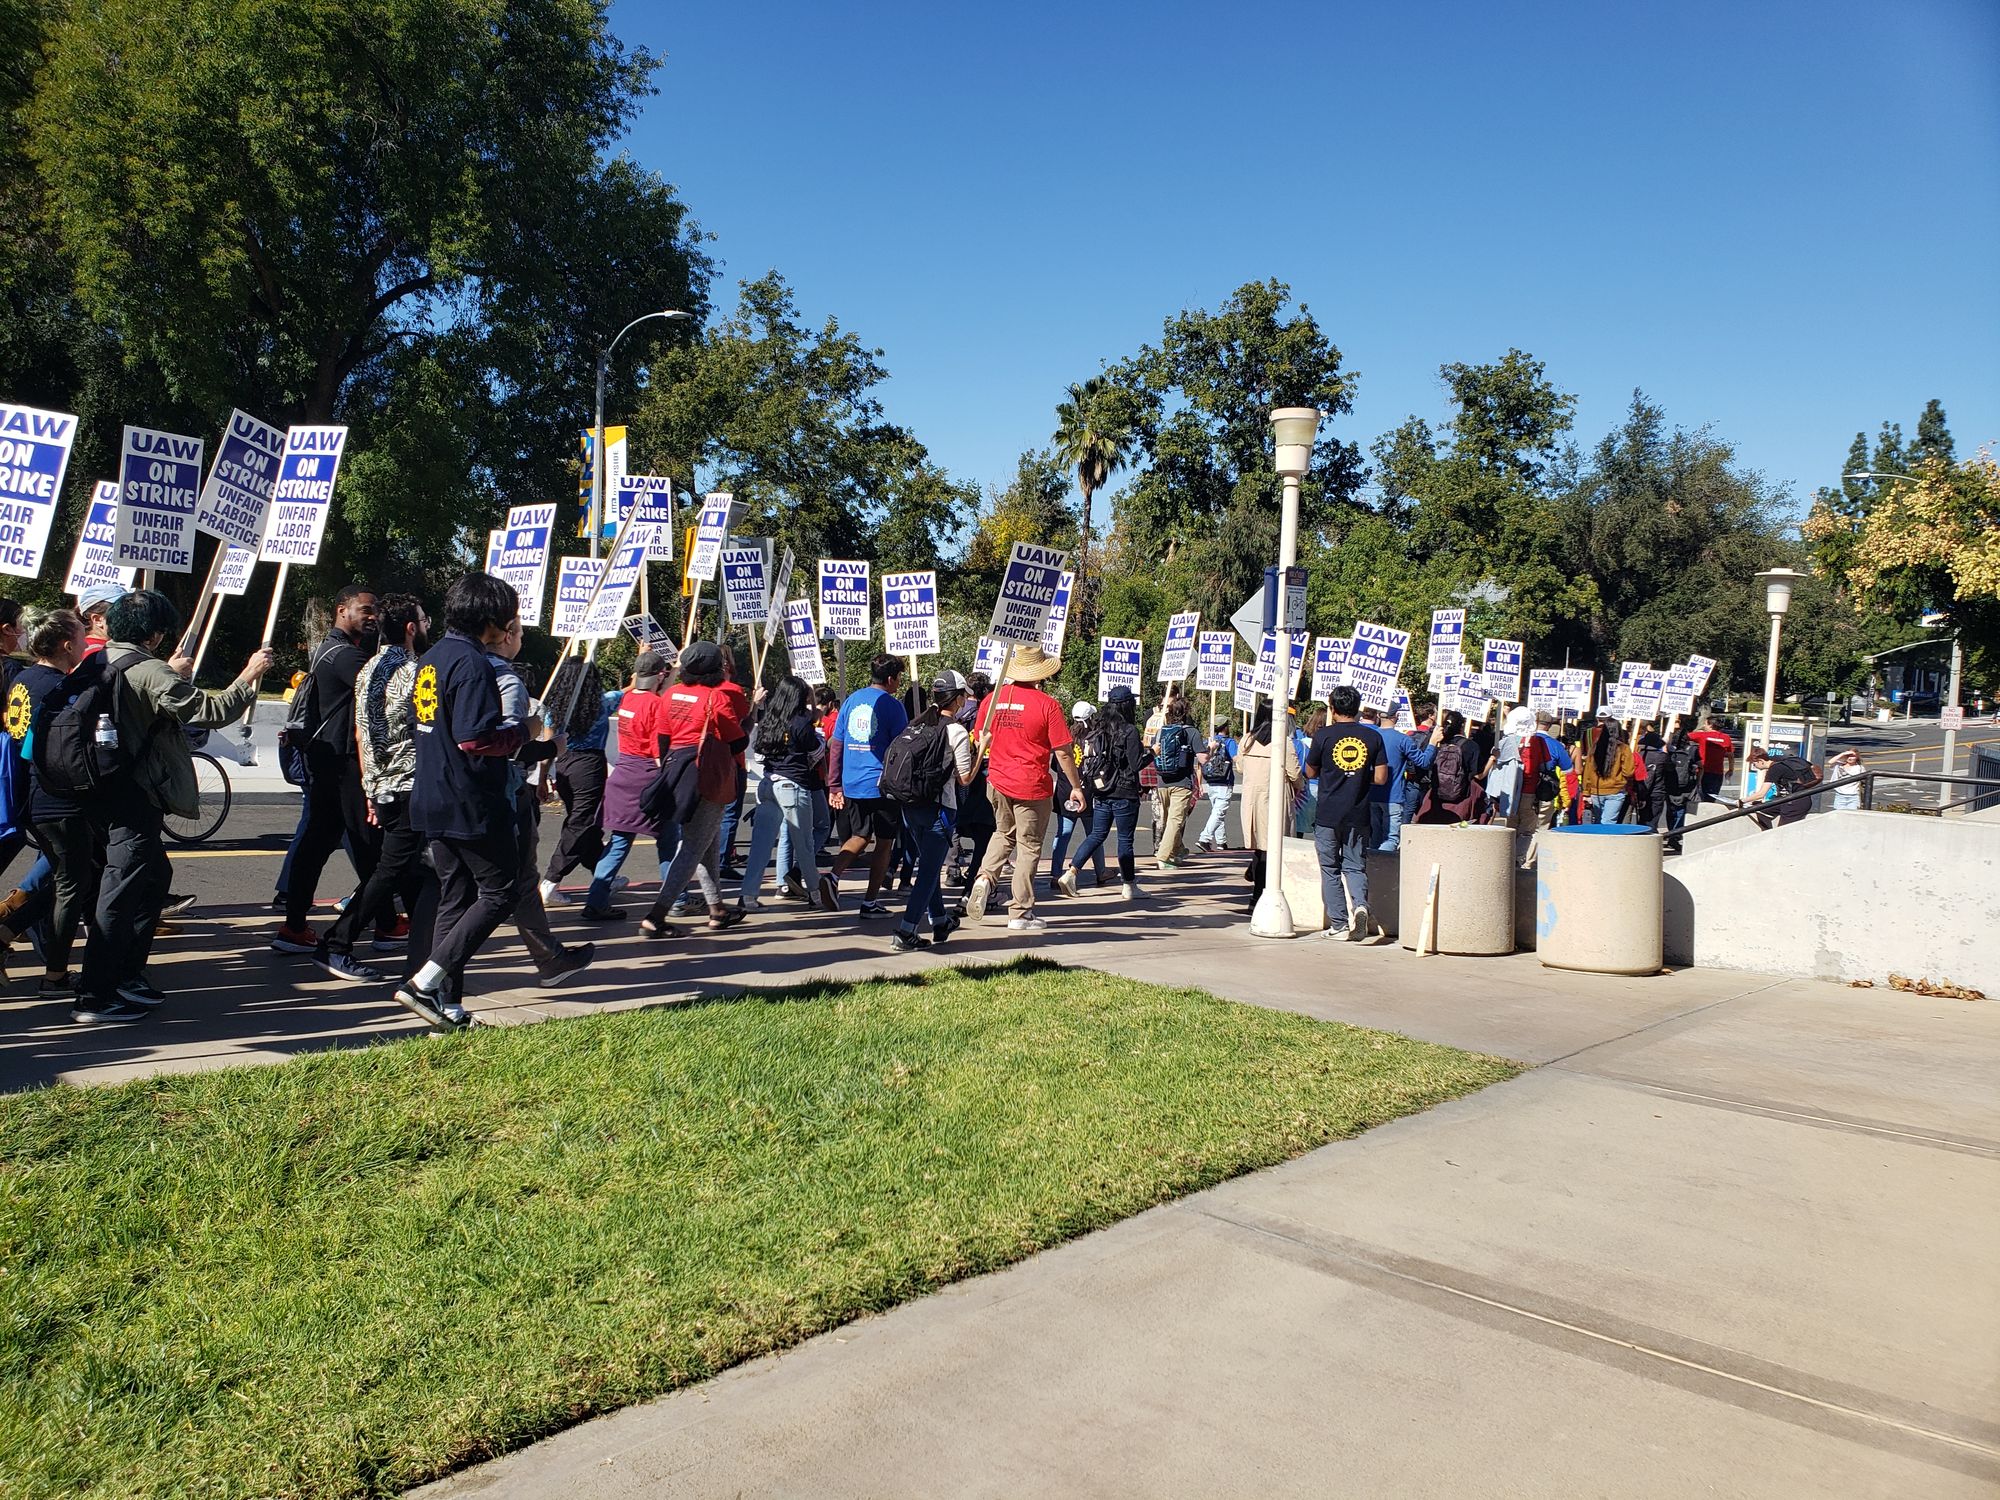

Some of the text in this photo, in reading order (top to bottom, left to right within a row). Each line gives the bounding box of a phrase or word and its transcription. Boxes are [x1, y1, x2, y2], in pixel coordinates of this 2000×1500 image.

[132, 432, 200, 461] UAW
[289, 431, 343, 451] UAW
[243, 449, 269, 474] ON
[296, 458, 319, 477] ON
[149, 462, 177, 484] ON
[218, 459, 276, 499] STRIKE
[277, 479, 331, 500] STRIKE
[620, 477, 667, 490] UAW
[126, 480, 195, 509] STRIKE
[217, 484, 264, 516] UNFAIR
[707, 497, 729, 509] UAW
[213, 500, 257, 529] LABOR
[278, 505, 318, 522] UNFAIR
[510, 508, 552, 527] UAW
[708, 511, 719, 526] ON
[132, 511, 184, 531] UNFAIR
[84, 522, 114, 543] STR
[198, 510, 260, 548] PRACTICE
[276, 523, 312, 538] LABOR
[700, 526, 723, 540] STRIKE
[133, 529, 180, 548] LABOR
[515, 530, 535, 548] ON
[624, 529, 652, 546] AW
[266, 539, 317, 556] PRACTICE
[697, 544, 715, 554] UNFAIR
[86, 548, 113, 563] UNFA
[119, 544, 189, 566] PRACTICE
[502, 548, 544, 566] STRIKE
[696, 555, 711, 565] LABOR
[722, 551, 760, 564] UAW
[1016, 545, 1065, 568] UAW
[83, 562, 120, 579] LABOR
[219, 564, 244, 576] ABOR
[502, 569, 534, 582] UNFAIR
[690, 564, 713, 576] PRACTICE
[736, 565, 752, 577] ON
[824, 563, 866, 575] UAW
[1024, 567, 1046, 583] ON
[575, 575, 595, 588] ON
[727, 578, 764, 590] STRIKE
[835, 578, 854, 590] ON
[886, 574, 931, 588] UAW
[560, 587, 590, 600] STRI
[733, 591, 762, 602] UNFAIR
[823, 590, 867, 603] STRIKE
[900, 589, 919, 603] ON
[1005, 580, 1053, 602] STRIKE
[597, 591, 624, 606] UNFAIR
[594, 605, 617, 619] LABOR
[736, 601, 762, 611] LABOR
[782, 603, 808, 619] UAW
[829, 606, 862, 616] UNFAIR
[887, 601, 934, 617] STRIKE
[1006, 602, 1042, 618] UNFAIR
[732, 609, 769, 620] PRACTICE
[1172, 615, 1197, 626] UAW
[1436, 612, 1463, 622] UAW
[585, 619, 619, 634] PRACTICE
[791, 620, 805, 634] ON
[831, 617, 860, 626] LABOR
[894, 619, 929, 631] UNFAIR
[1003, 614, 1037, 630] LABOR
[824, 626, 867, 636] PRACTICE
[896, 630, 927, 640] LABOR
[992, 624, 1041, 643] PRACTICE
[1175, 627, 1188, 638] ON
[1358, 625, 1407, 646] UAW
[1441, 624, 1454, 634] ON
[787, 633, 816, 648] STRIKE
[1166, 637, 1192, 650] STRIKE
[1203, 633, 1232, 642] UAW
[1432, 633, 1461, 644] STRIKE
[889, 639, 936, 651] PRACTICE
[1105, 639, 1140, 650] UAW
[1209, 644, 1223, 654] ON
[1367, 643, 1389, 659] ON
[1434, 647, 1455, 655] UNFAIR
[1488, 641, 1521, 652] UAW
[794, 650, 816, 660] UNFAIR
[1114, 651, 1130, 663] ON
[1166, 652, 1186, 661] UNFAIR
[1200, 653, 1231, 663] STRIKE
[1328, 651, 1345, 662] ON
[1496, 653, 1511, 663] ON
[1693, 656, 1714, 666] UAW
[797, 660, 817, 671] LABOR
[1103, 660, 1139, 674] STRIKE
[1165, 660, 1183, 669] LABOR
[1203, 665, 1226, 673] UNFAIR
[1350, 653, 1398, 675] STRIKE
[1429, 663, 1457, 671] PRACTICE
[1485, 661, 1519, 674] STRIKE
[1675, 666, 1698, 674] UAW
[795, 669, 824, 681] PRACTICE
[1160, 668, 1185, 677] PRACTICE
[1321, 675, 1341, 683] UNFA
[1351, 669, 1388, 686] UNFAIR
[1490, 674, 1514, 683] UNFAIR
[1566, 670, 1591, 678] UAW
[1636, 671, 1664, 680] UAW
[1107, 674, 1134, 685] UNFAIR
[1199, 680, 1229, 688] PRACTICE
[1351, 680, 1383, 696] LABOR
[1490, 682, 1512, 691] LABOR
[1483, 688, 1517, 699] PRACTICE
[1360, 693, 1389, 708] CTICE
